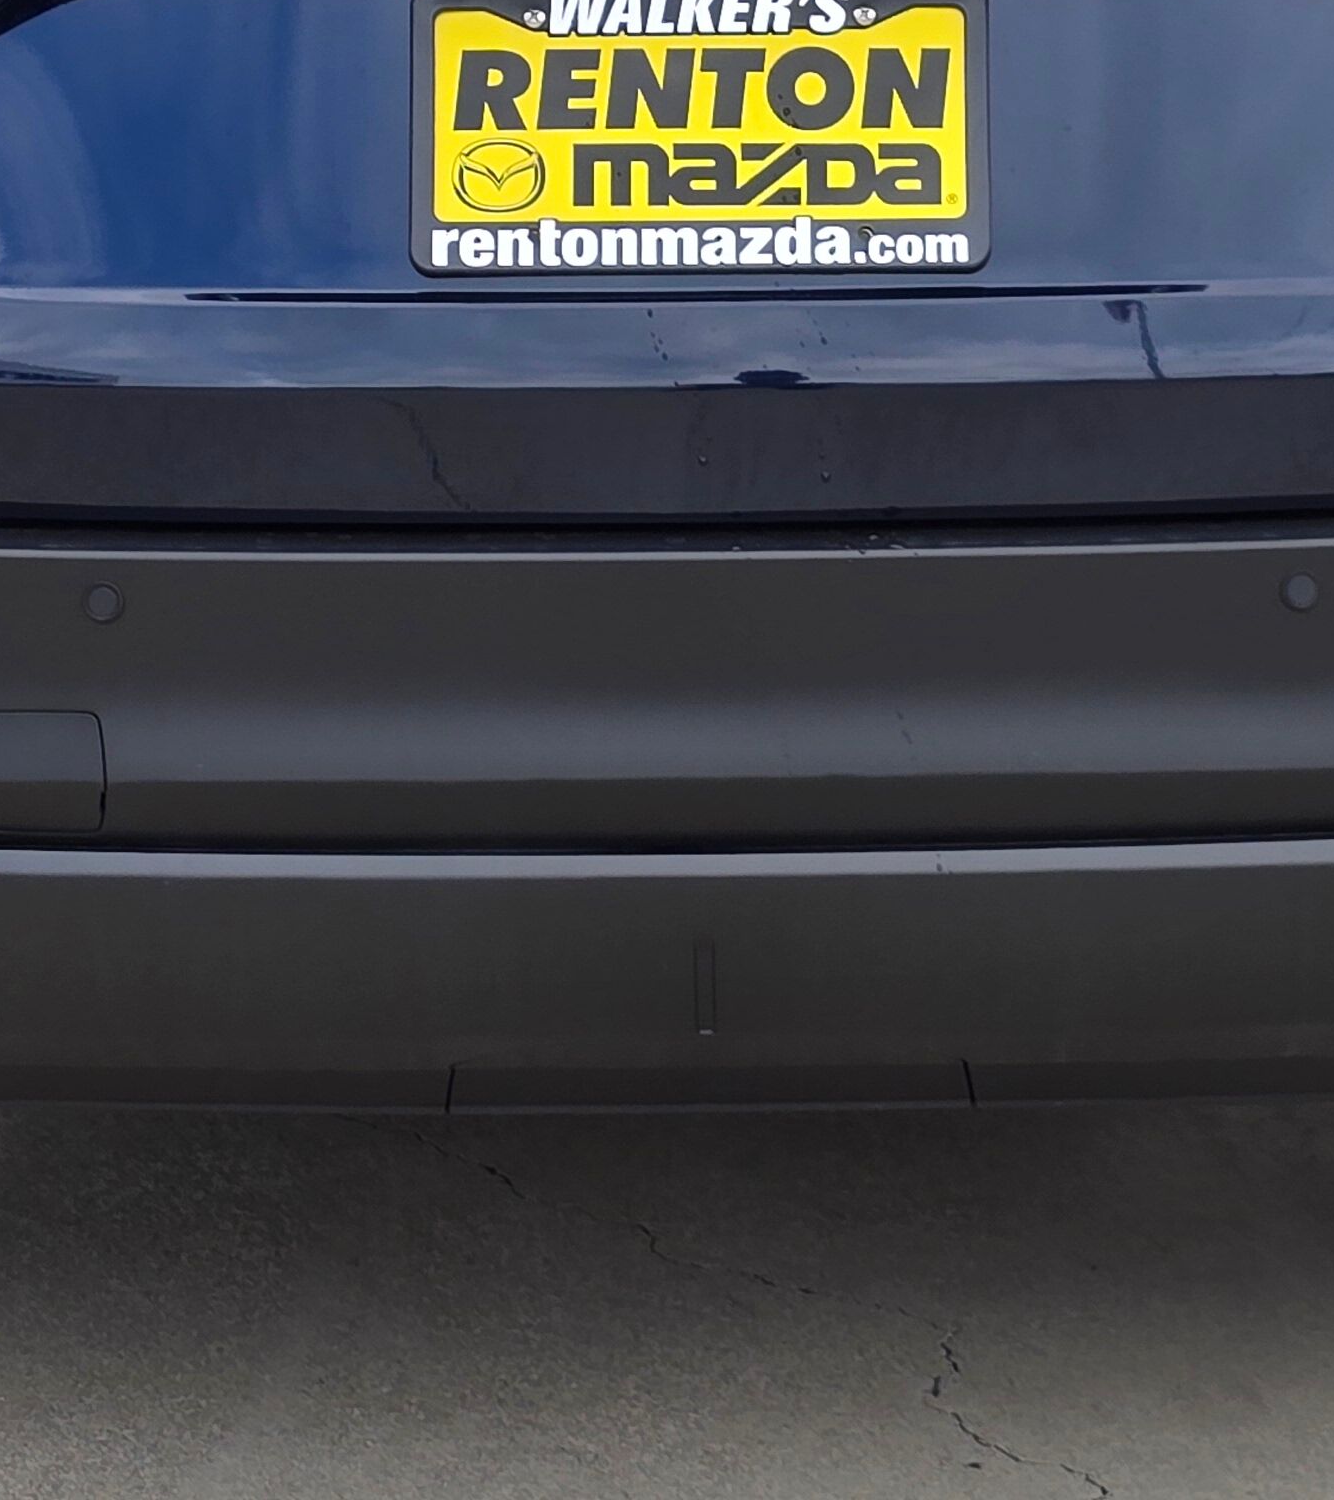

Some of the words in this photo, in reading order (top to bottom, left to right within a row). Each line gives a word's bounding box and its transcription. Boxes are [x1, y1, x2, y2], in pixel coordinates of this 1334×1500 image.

[453, 47, 952, 131] RENTON
[573, 143, 942, 206] mazda
[430, 217, 970, 267] rentonmazda.com
